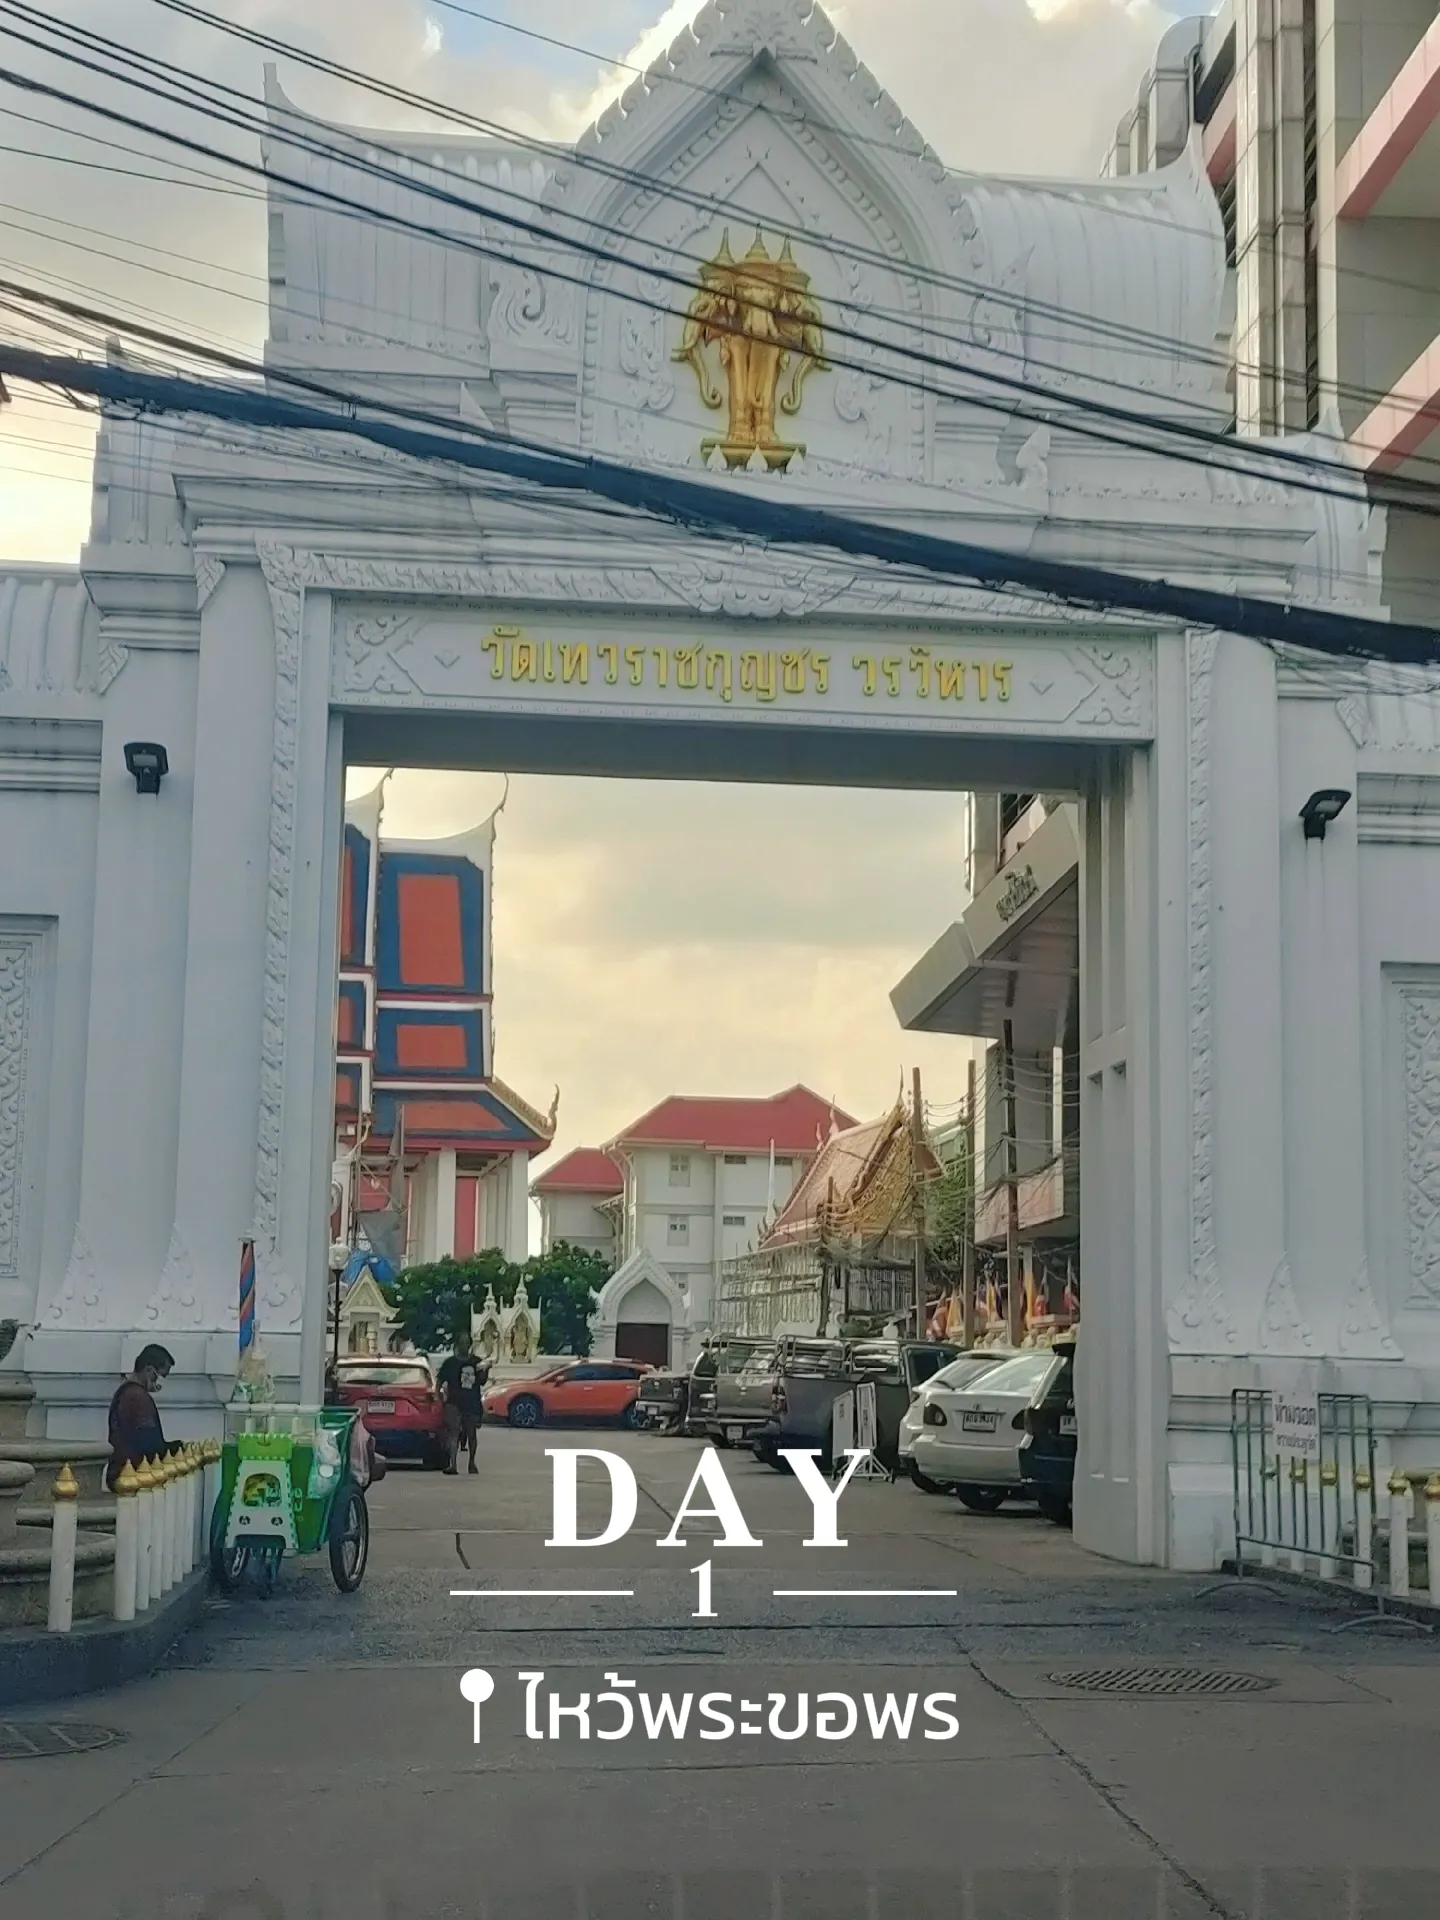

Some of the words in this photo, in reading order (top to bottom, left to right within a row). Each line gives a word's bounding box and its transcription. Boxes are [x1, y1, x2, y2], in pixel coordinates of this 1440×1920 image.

[480, 624, 831, 702] วัดเทวราชกุญชร
[852, 646, 1014, 701] วรวิหาร
